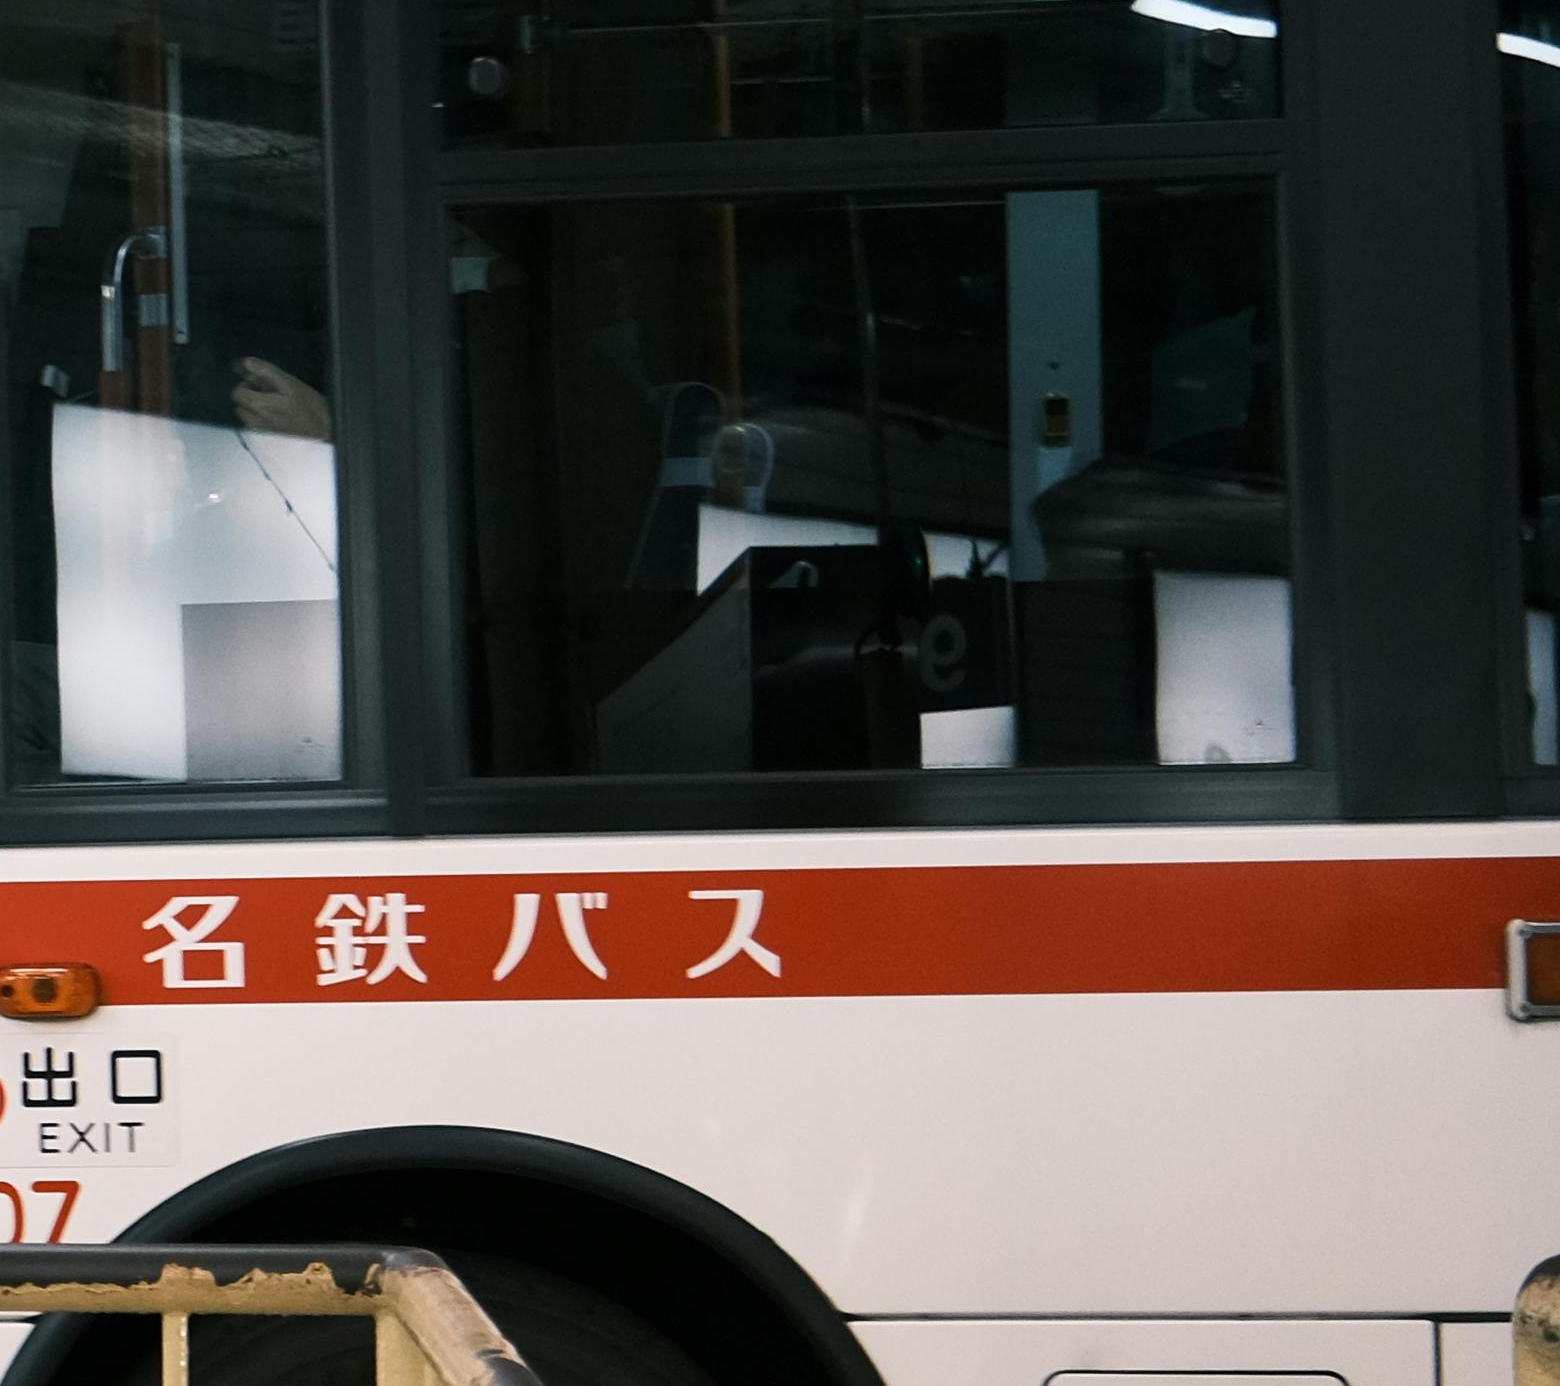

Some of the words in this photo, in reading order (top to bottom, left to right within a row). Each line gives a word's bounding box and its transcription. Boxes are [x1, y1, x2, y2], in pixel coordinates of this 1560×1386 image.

[141, 889, 782, 991] 名鉄バス
[22, 1047, 162, 1107] 出口
[39, 1122, 145, 1153] EXIT
